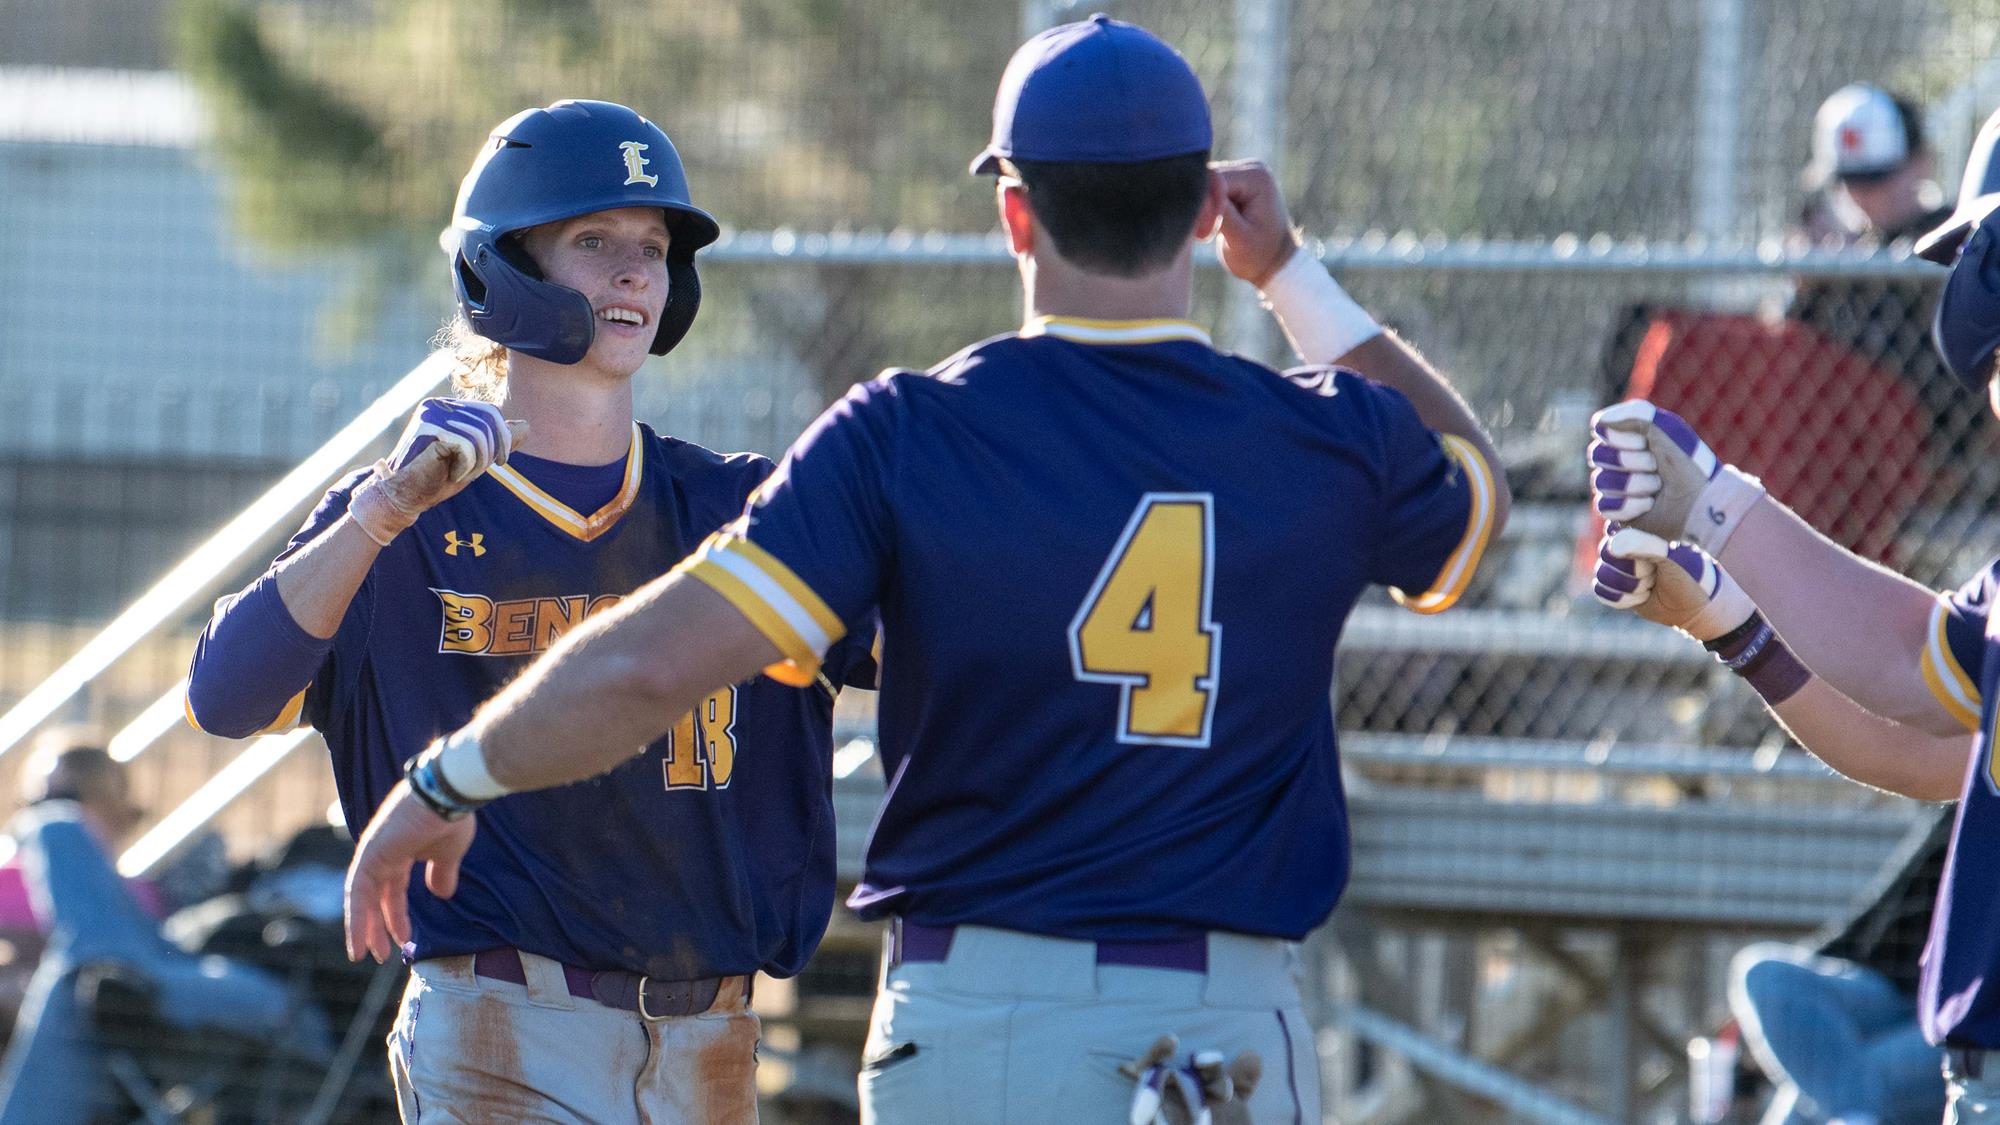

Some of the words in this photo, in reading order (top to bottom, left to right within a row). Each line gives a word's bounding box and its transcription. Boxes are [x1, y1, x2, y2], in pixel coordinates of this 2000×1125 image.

[619, 141, 658, 187] E
[428, 586, 630, 656] BEN
[1067, 491, 1222, 749] 4
[662, 683, 737, 791] 18
